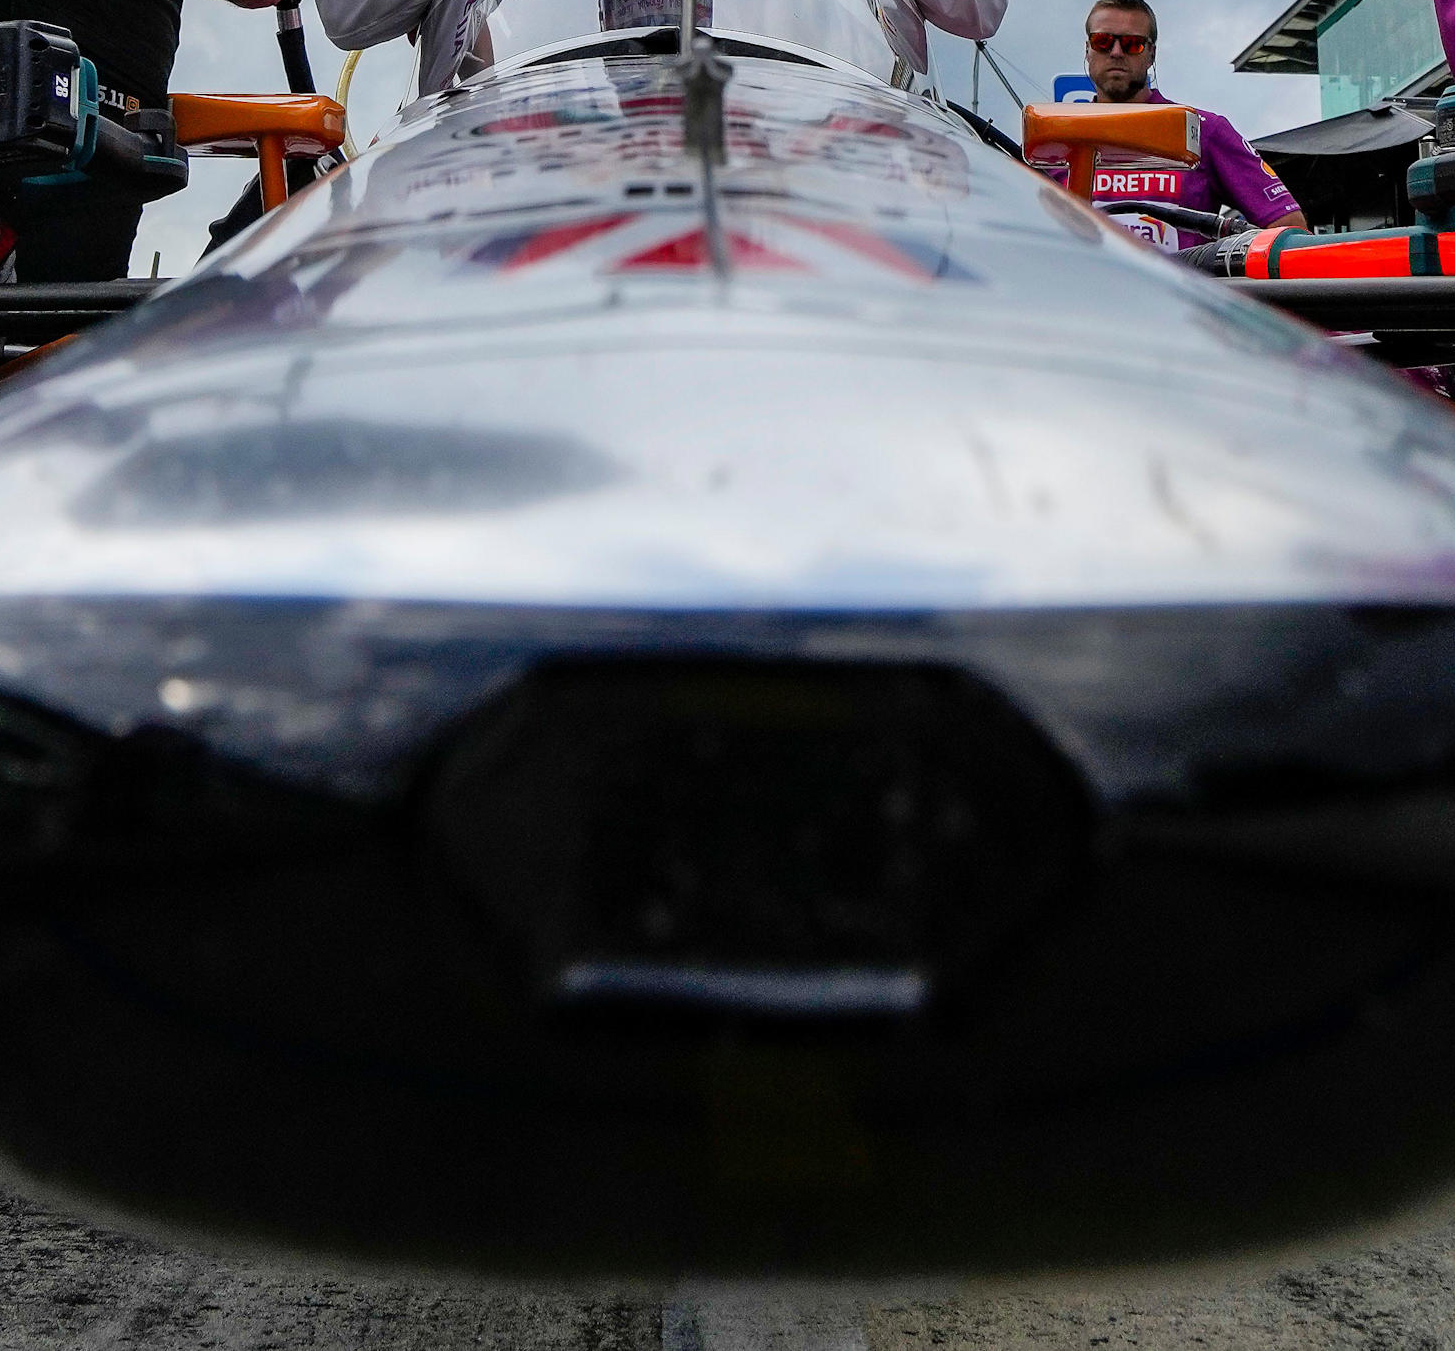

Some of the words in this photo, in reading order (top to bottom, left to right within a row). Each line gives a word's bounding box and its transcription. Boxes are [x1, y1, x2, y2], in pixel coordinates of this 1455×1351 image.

[55, 74, 69, 99] 28
[97, 85, 126, 110] 5.11
[1094, 173, 1176, 194] DRETTI
